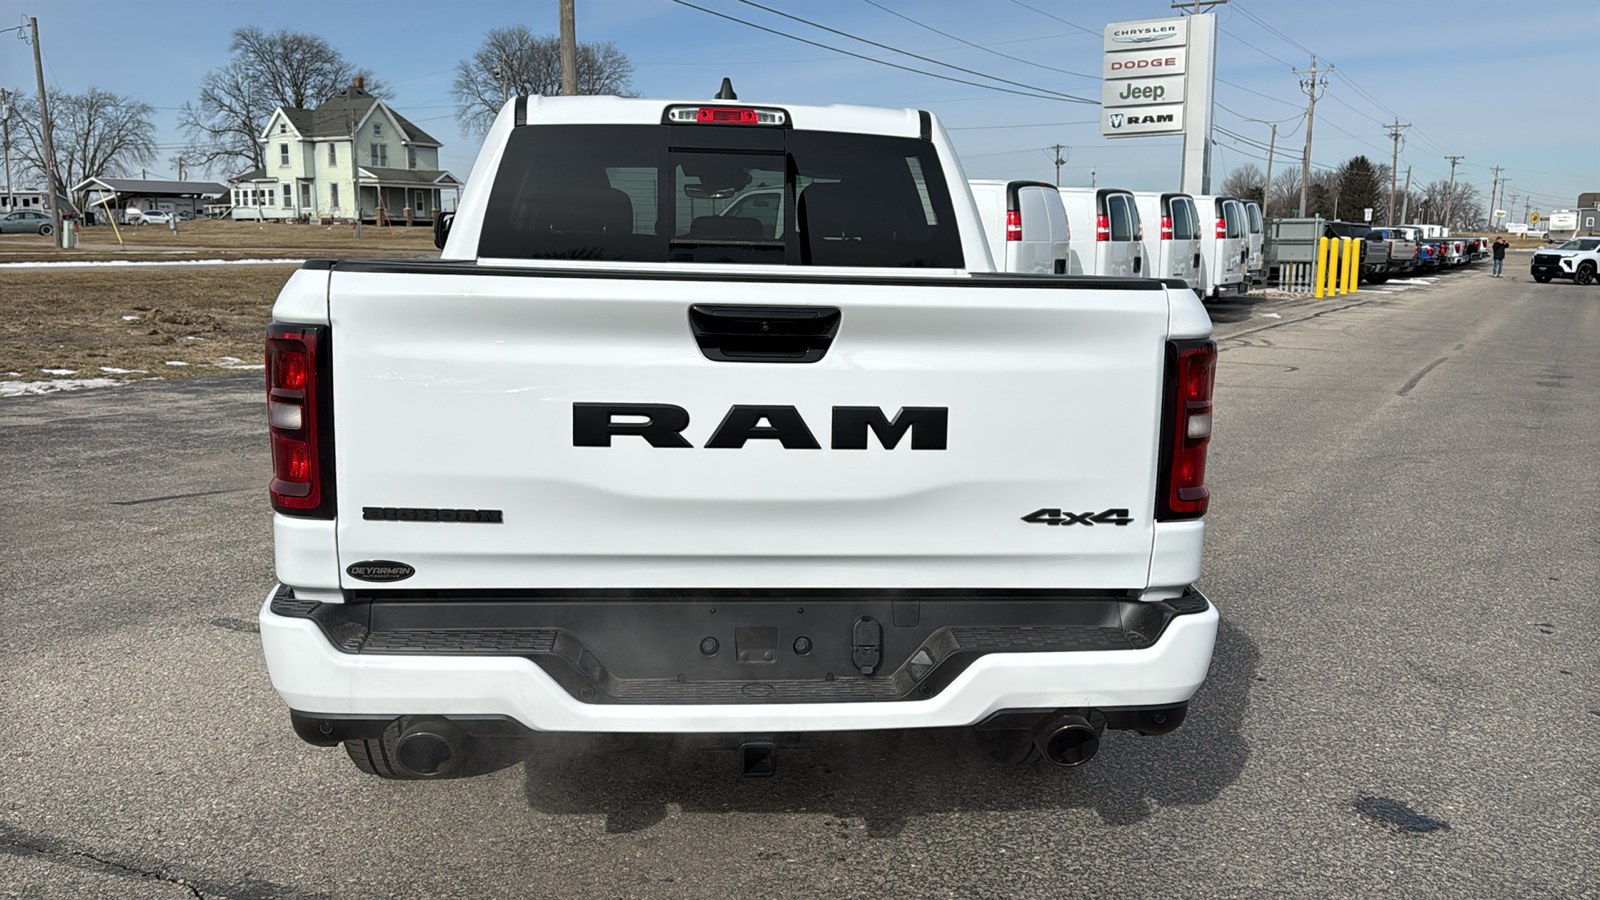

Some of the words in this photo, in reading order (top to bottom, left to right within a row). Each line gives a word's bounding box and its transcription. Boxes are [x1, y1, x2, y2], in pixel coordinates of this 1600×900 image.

[1114, 26, 1175, 36] CHRYSLER
[1111, 57, 1176, 70] DODGE
[1119, 83, 1165, 101] Jeep
[1127, 114, 1173, 124] RAM
[572, 402, 949, 450] RAM
[1020, 508, 1135, 526] 4x4
